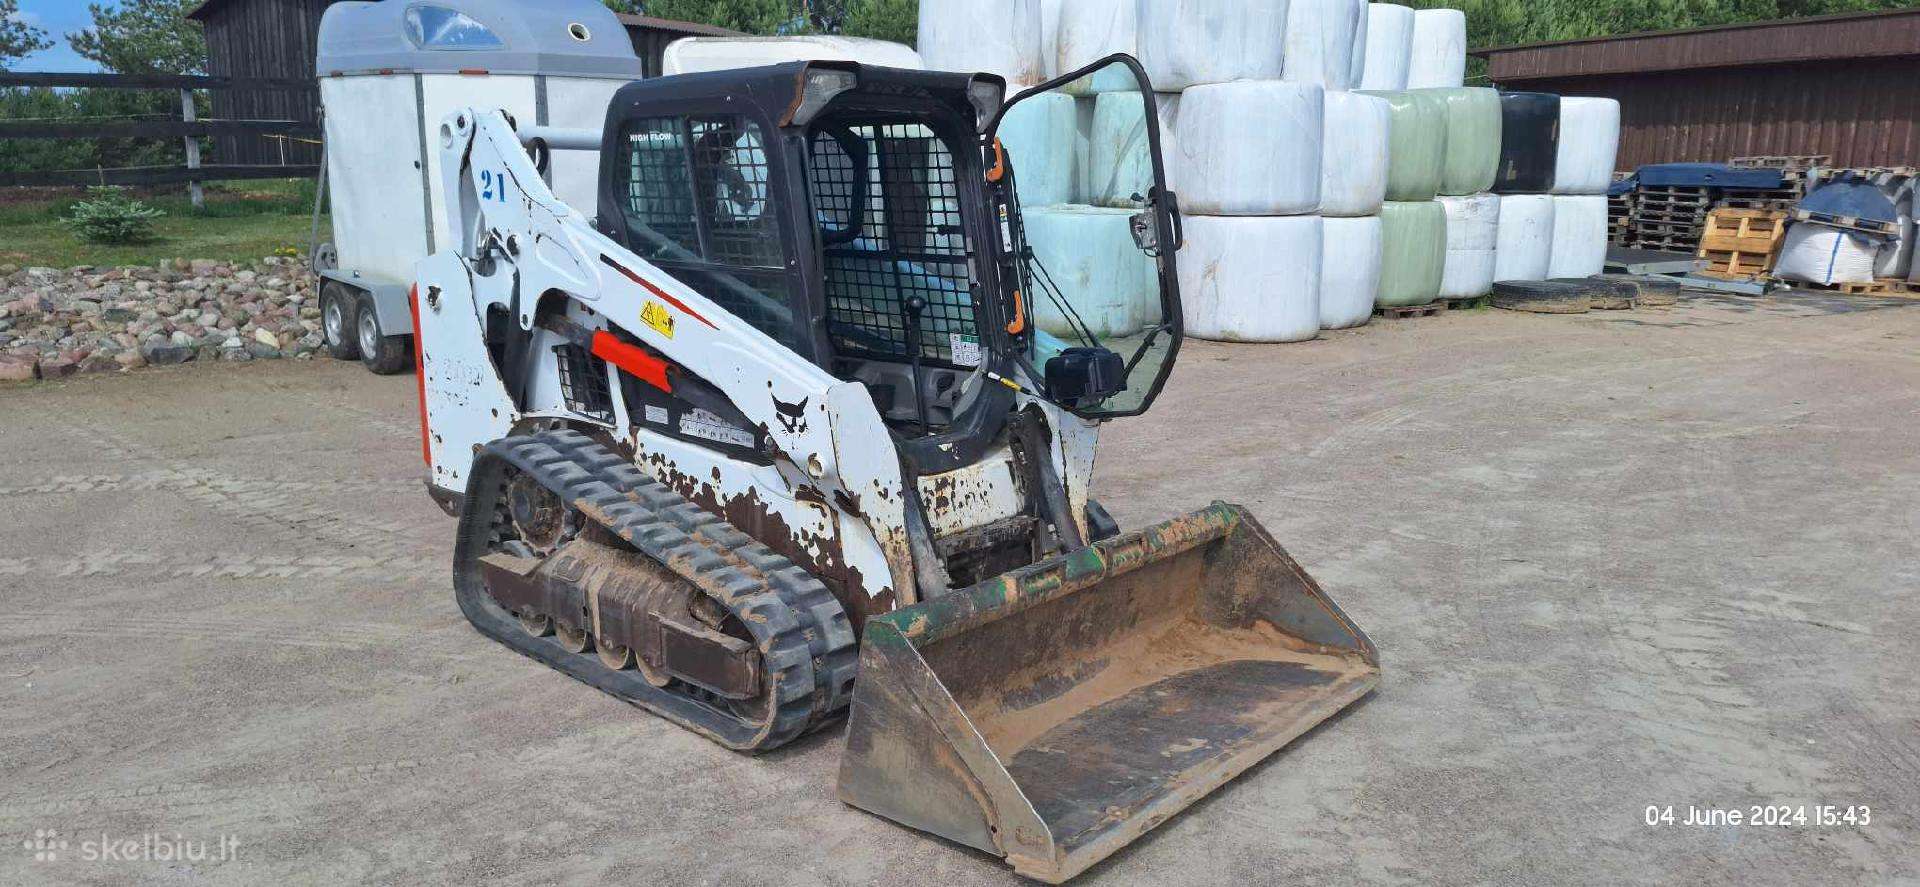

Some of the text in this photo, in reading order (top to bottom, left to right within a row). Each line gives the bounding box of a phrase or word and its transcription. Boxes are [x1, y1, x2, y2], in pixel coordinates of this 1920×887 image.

[629, 132, 671, 142] HIGH FLOW
[481, 169, 505, 202] 21
